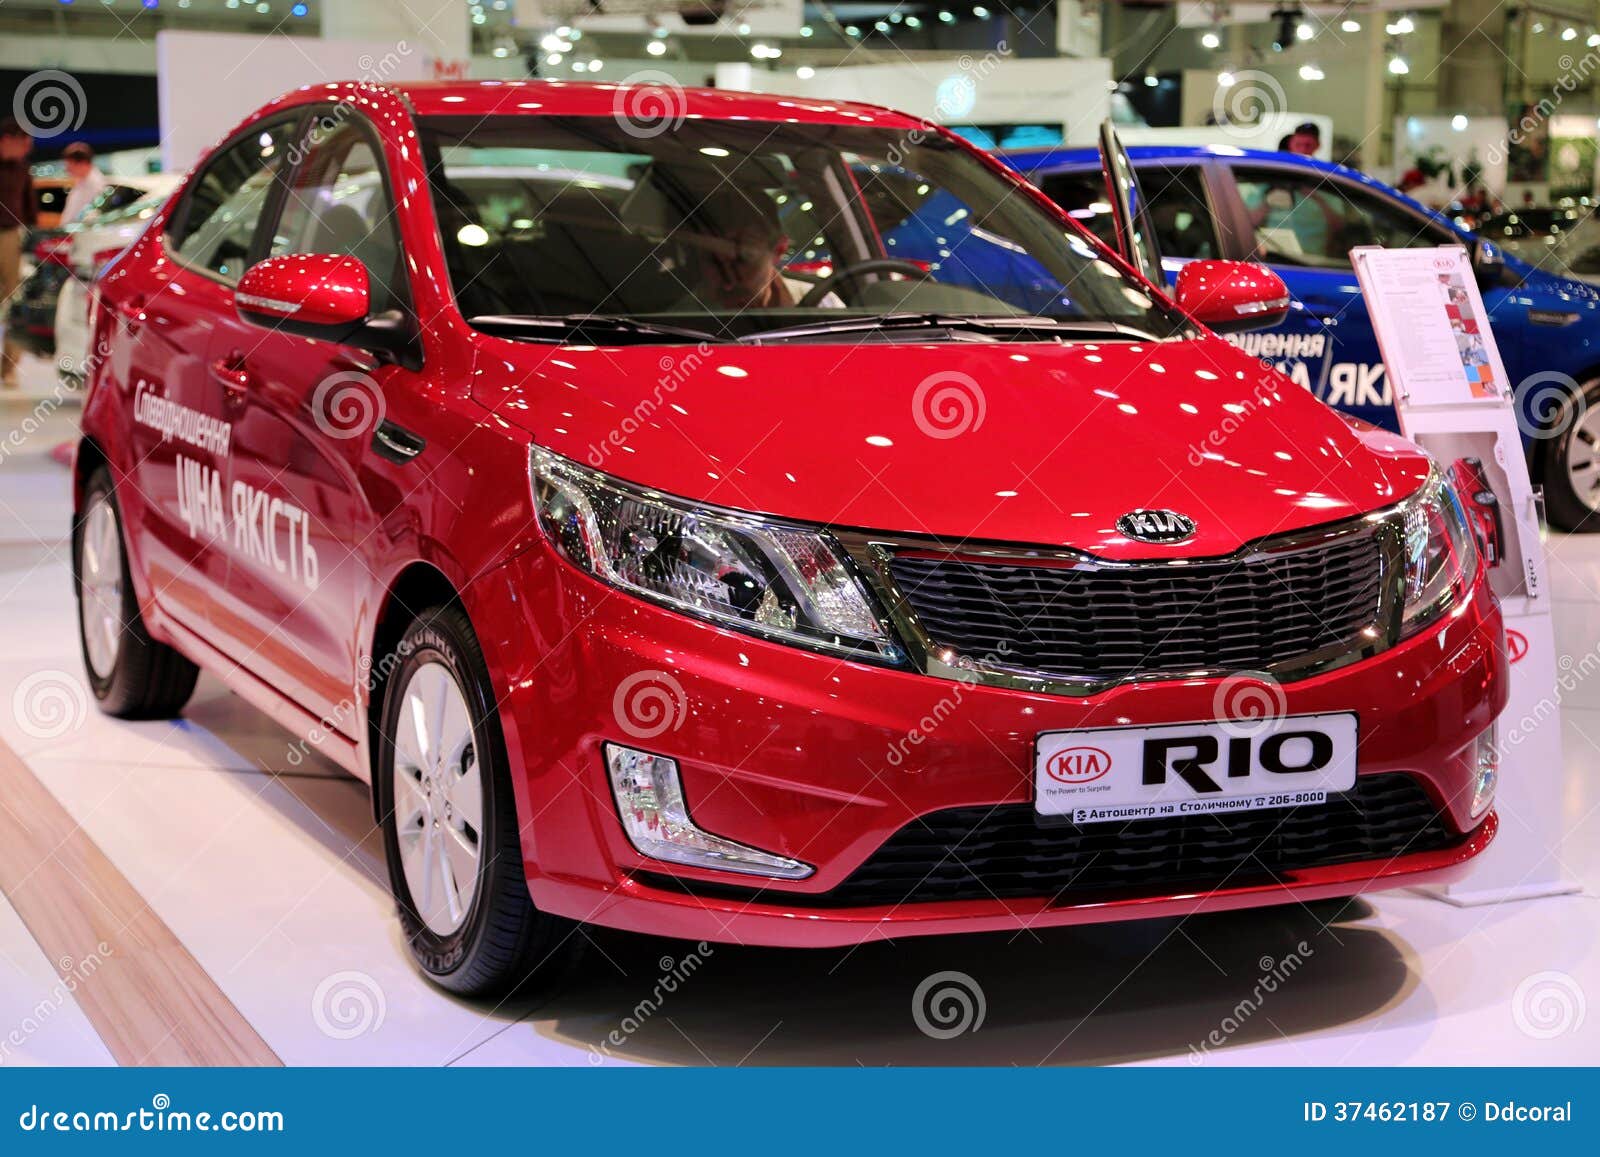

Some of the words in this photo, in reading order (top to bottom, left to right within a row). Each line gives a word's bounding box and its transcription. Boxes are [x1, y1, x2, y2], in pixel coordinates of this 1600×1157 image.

[232, 480, 319, 590] ЯКІСТЬ
[1058, 754, 1100, 776] KIA
[1142, 730, 1333, 794] RIO
[1058, 787, 1077, 795] Power
[1086, 785, 1111, 793] Surprise
[1089, 805, 1155, 819] Автоцентр
[1160, 805, 1174, 813] на
[1180, 799, 1252, 812] Столичному
[1268, 791, 1324, 806] 206-8000
